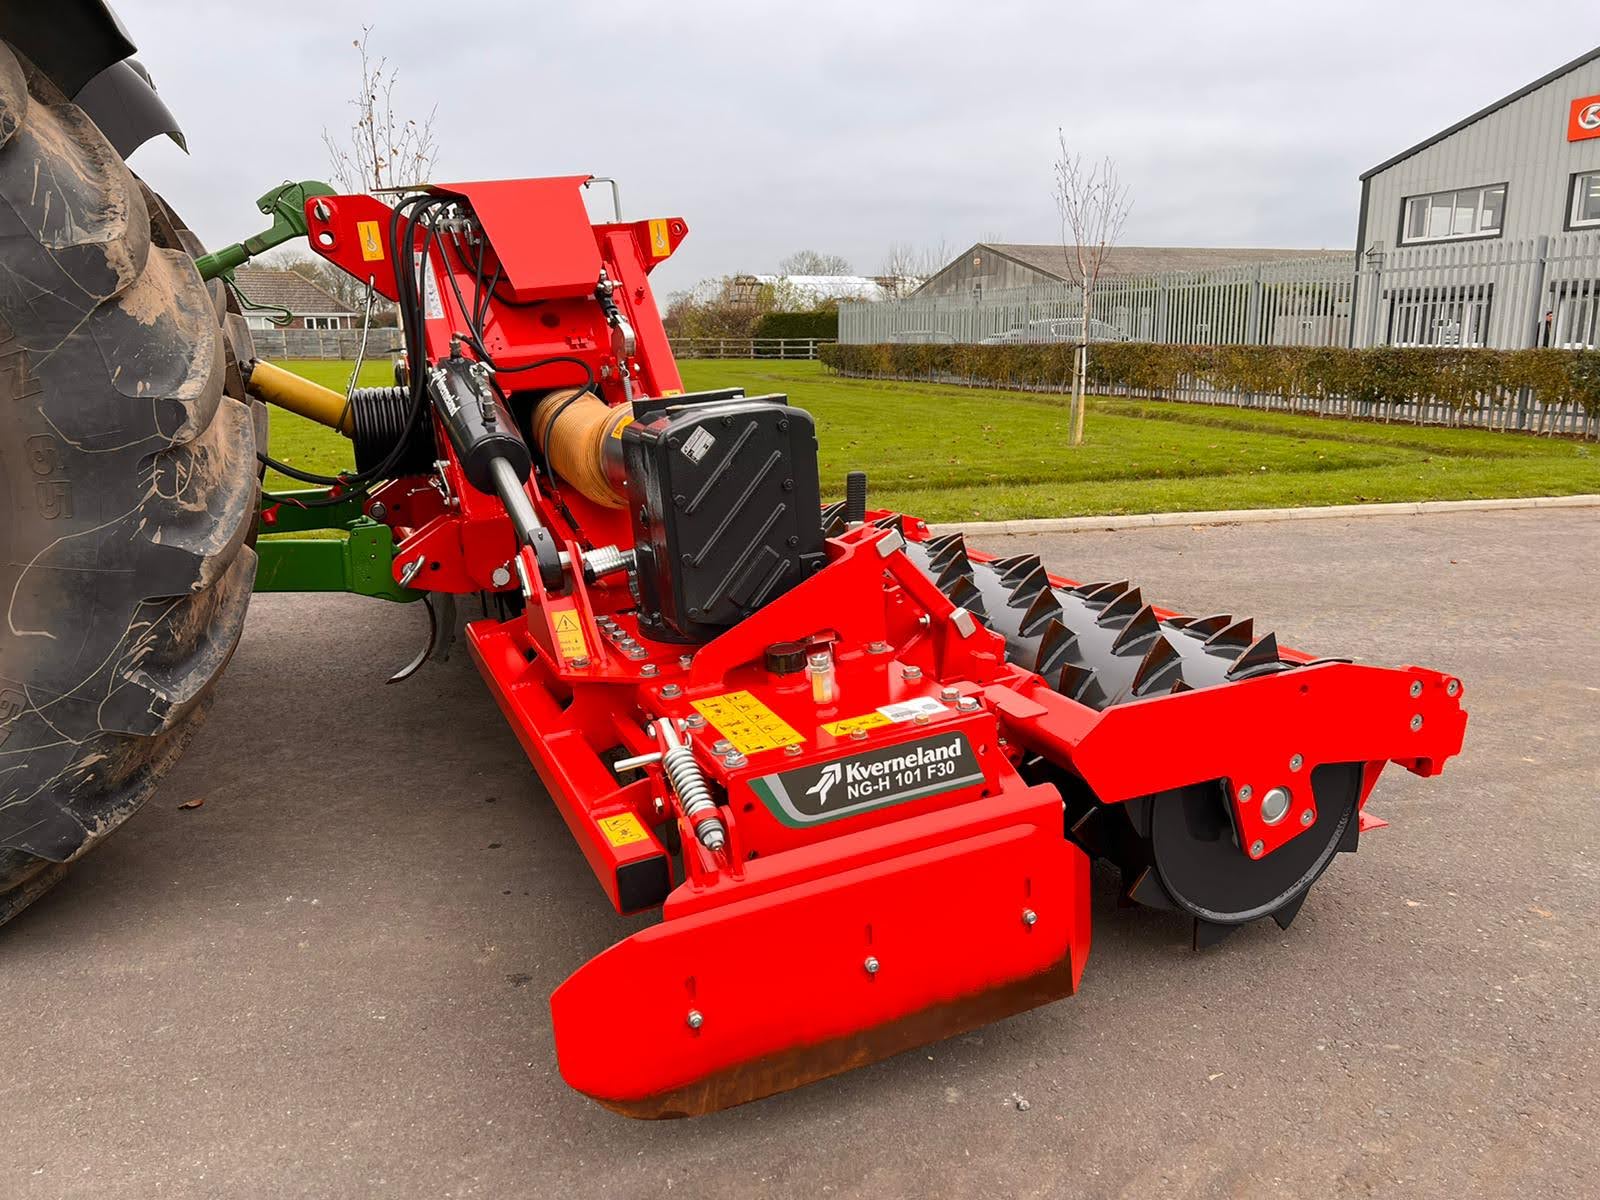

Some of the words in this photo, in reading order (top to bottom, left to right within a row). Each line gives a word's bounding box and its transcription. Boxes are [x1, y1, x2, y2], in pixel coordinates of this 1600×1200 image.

[846, 738, 962, 783] Kverneland
[847, 776, 890, 799] NG-H
[895, 768, 921, 786] 101
[927, 761, 955, 779] F30
